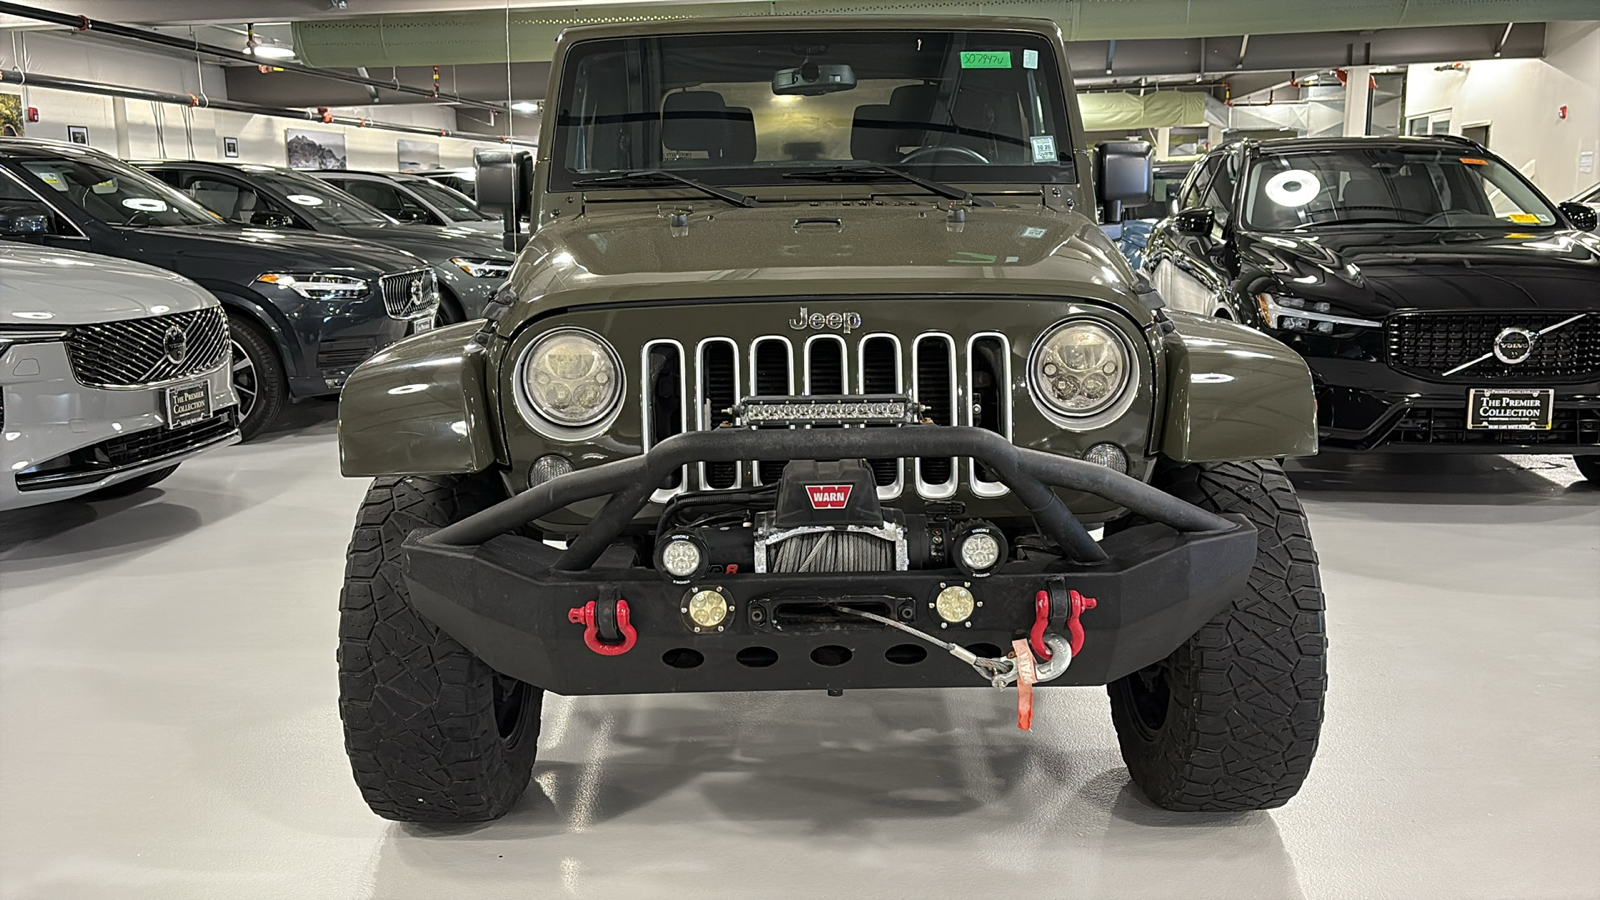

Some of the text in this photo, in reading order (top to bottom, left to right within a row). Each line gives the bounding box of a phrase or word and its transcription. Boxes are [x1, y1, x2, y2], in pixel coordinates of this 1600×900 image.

[788, 306, 862, 334] Jeep
[173, 390, 204, 404] THE PREMIER
[1480, 397, 1541, 407] THE PREMIER
[173, 399, 205, 414] COLLECTION
[1479, 406, 1540, 417] COLLECTION
[813, 492, 844, 502] WARN
